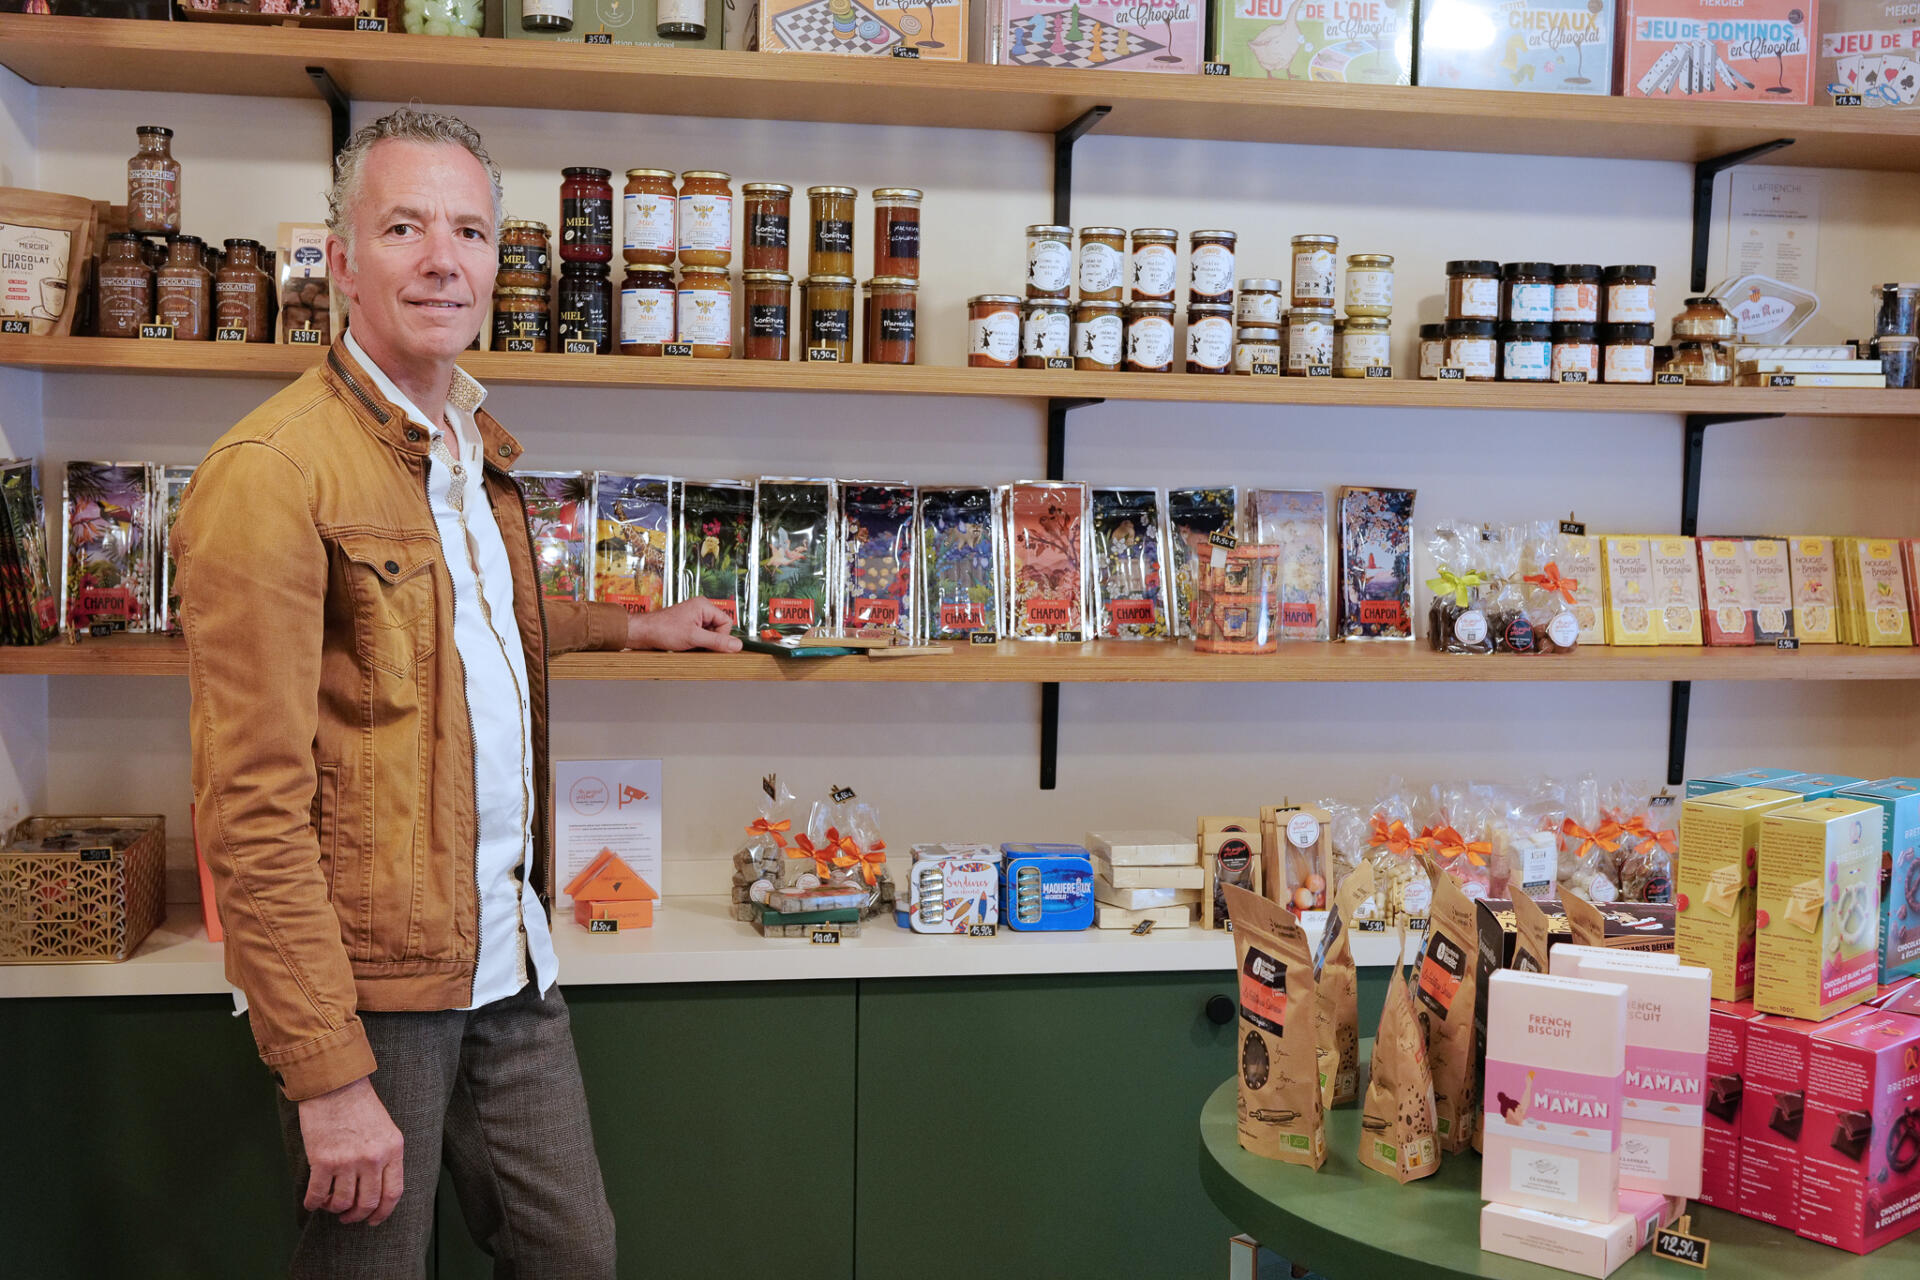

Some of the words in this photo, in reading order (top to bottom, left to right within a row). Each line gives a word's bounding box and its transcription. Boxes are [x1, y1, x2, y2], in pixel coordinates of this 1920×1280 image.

[1116, 14, 1129, 23] en
[1129, 4, 1191, 30] Chocolat
[1244, 0, 1283, 17] JEU
[1305, 3, 1325, 20] DE
[1333, 0, 1379, 22] L'OIE
[1508, 10, 1601, 32] CHEVAUX
[1641, 20, 1677, 39] JEU
[1681, 24, 1700, 38] DE
[1706, 18, 1794, 42] DOMINOS
[1528, 34, 1541, 46] en
[1541, 26, 1600, 52] Chocolat
[1833, 34, 1874, 54] JEU
[1880, 33, 1902, 50] DE
[1730, 46, 1742, 57] en
[1742, 37, 1801, 62] Chocolat
[566, 217, 594, 228] MIEL
[19, 241, 50, 251] MERCIER
[2, 252, 51, 270] CHOCOLAT
[503, 255, 527, 264] MIEL
[560, 311, 586, 321] MIEL
[512, 321, 540, 332] MIEL
[1655, 558, 1686, 566] NOUGAT
[1707, 559, 1736, 567] NOUGAT
[1749, 559, 1778, 567] NOUGAT
[1795, 557, 1824, 565] NOUGAT
[1864, 560, 1892, 568] NOUGAT
[84, 597, 125, 610] CHAPON
[944, 612, 981, 625] CHAPON
[1030, 607, 1066, 620] CHAPON
[1116, 607, 1152, 620] CHAPON
[1285, 611, 1313, 623] HAPON
[1364, 607, 1398, 620] CHAPON
[945, 876, 989, 890] Sardines
[1896, 939, 1920, 952] CHOCOLA
[1627, 1000, 1662, 1013] ENCH
[1529, 1014, 1572, 1029] FRENCH
[1628, 1010, 1662, 1022] SCUIT
[1527, 1024, 1572, 1040] BISCUIT
[1626, 1070, 1700, 1094] MAMAN
[1533, 1092, 1609, 1119] MAMAN
[1879, 1199, 1910, 1218] CHOCOLAT
[1761, 1211, 1777, 1222] 100G
[1821, 1233, 1838, 1244] 100G
[1659, 1234, 1699, 1263] 12,90€
